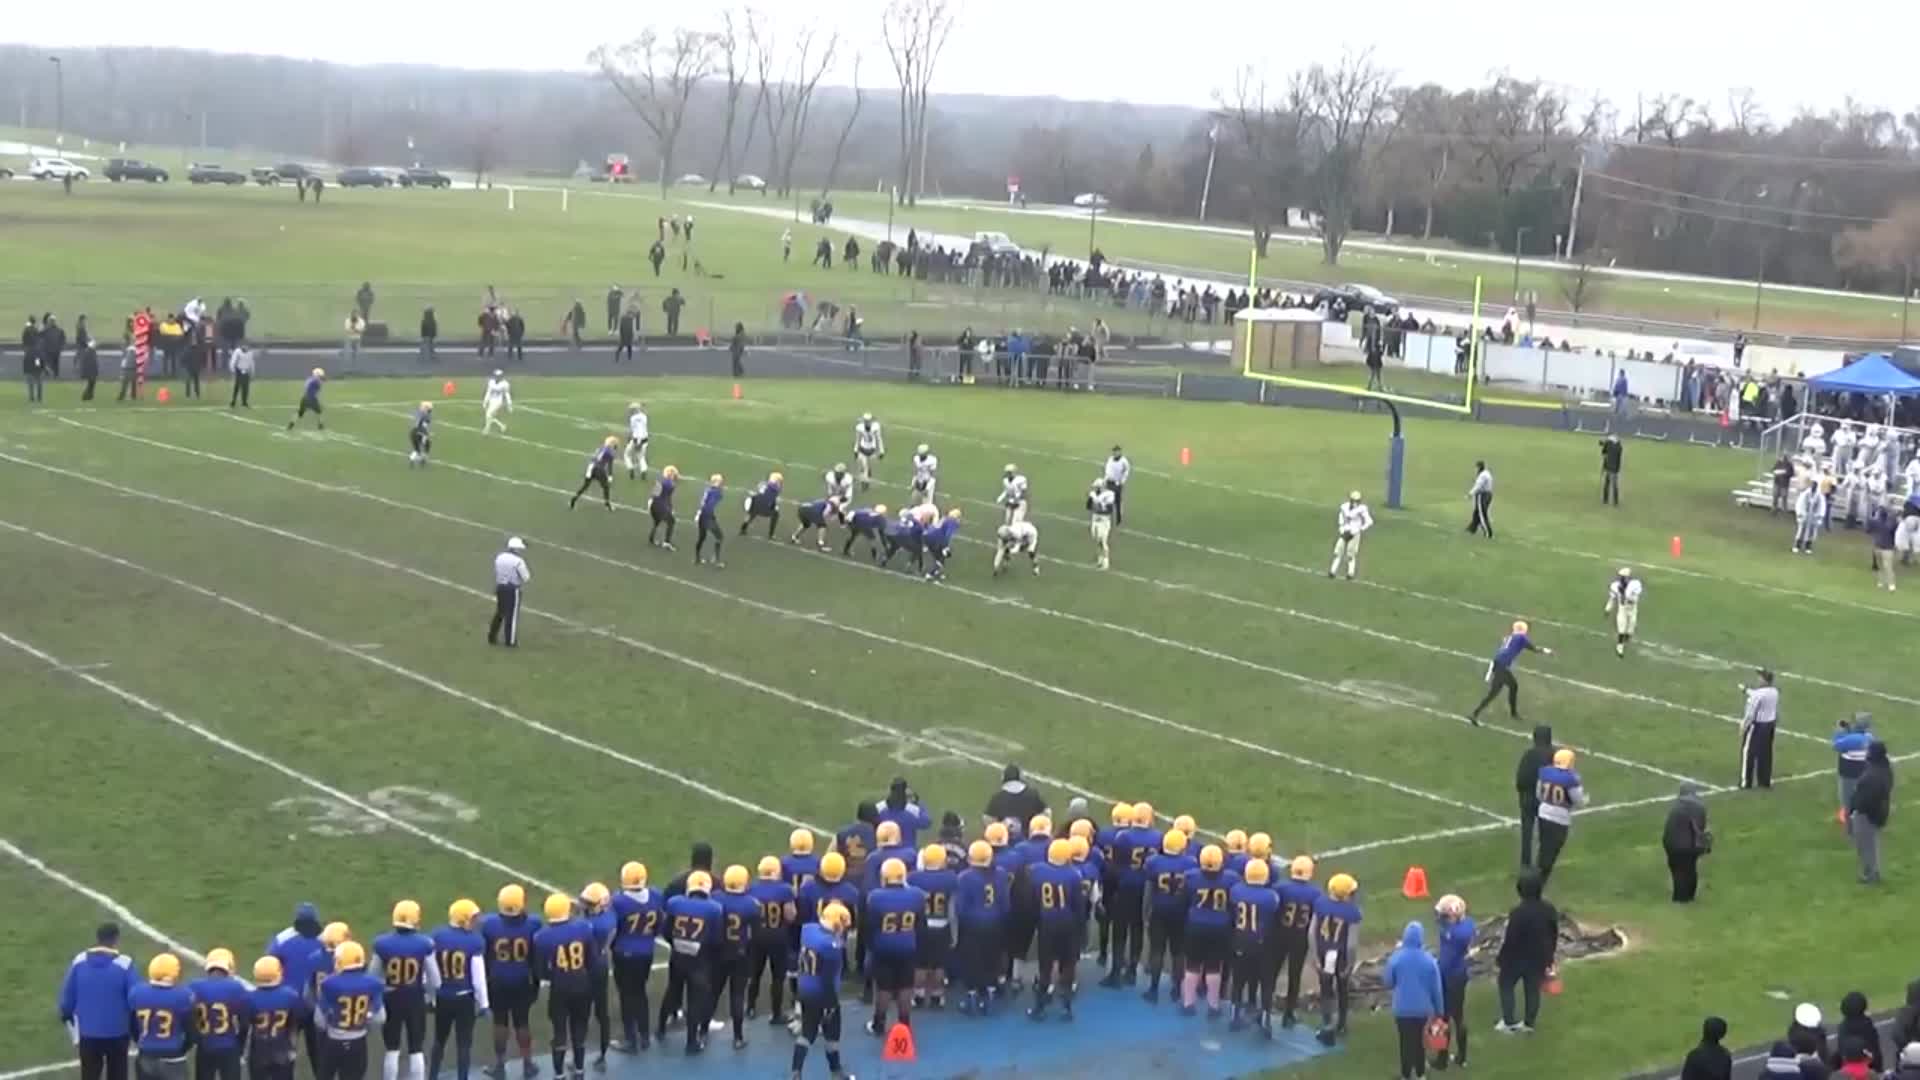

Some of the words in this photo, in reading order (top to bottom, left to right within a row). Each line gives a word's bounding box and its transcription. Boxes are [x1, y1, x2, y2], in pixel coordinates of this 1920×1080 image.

[1041, 881, 1066, 910] 81
[626, 909, 657, 935] 72
[673, 914, 705, 940] 57
[1236, 900, 1258, 932] 31
[1320, 914, 1345, 943] 47
[556, 939, 585, 972] 48
[136, 1007, 173, 1039] 73
[337, 995, 370, 1028] 38
